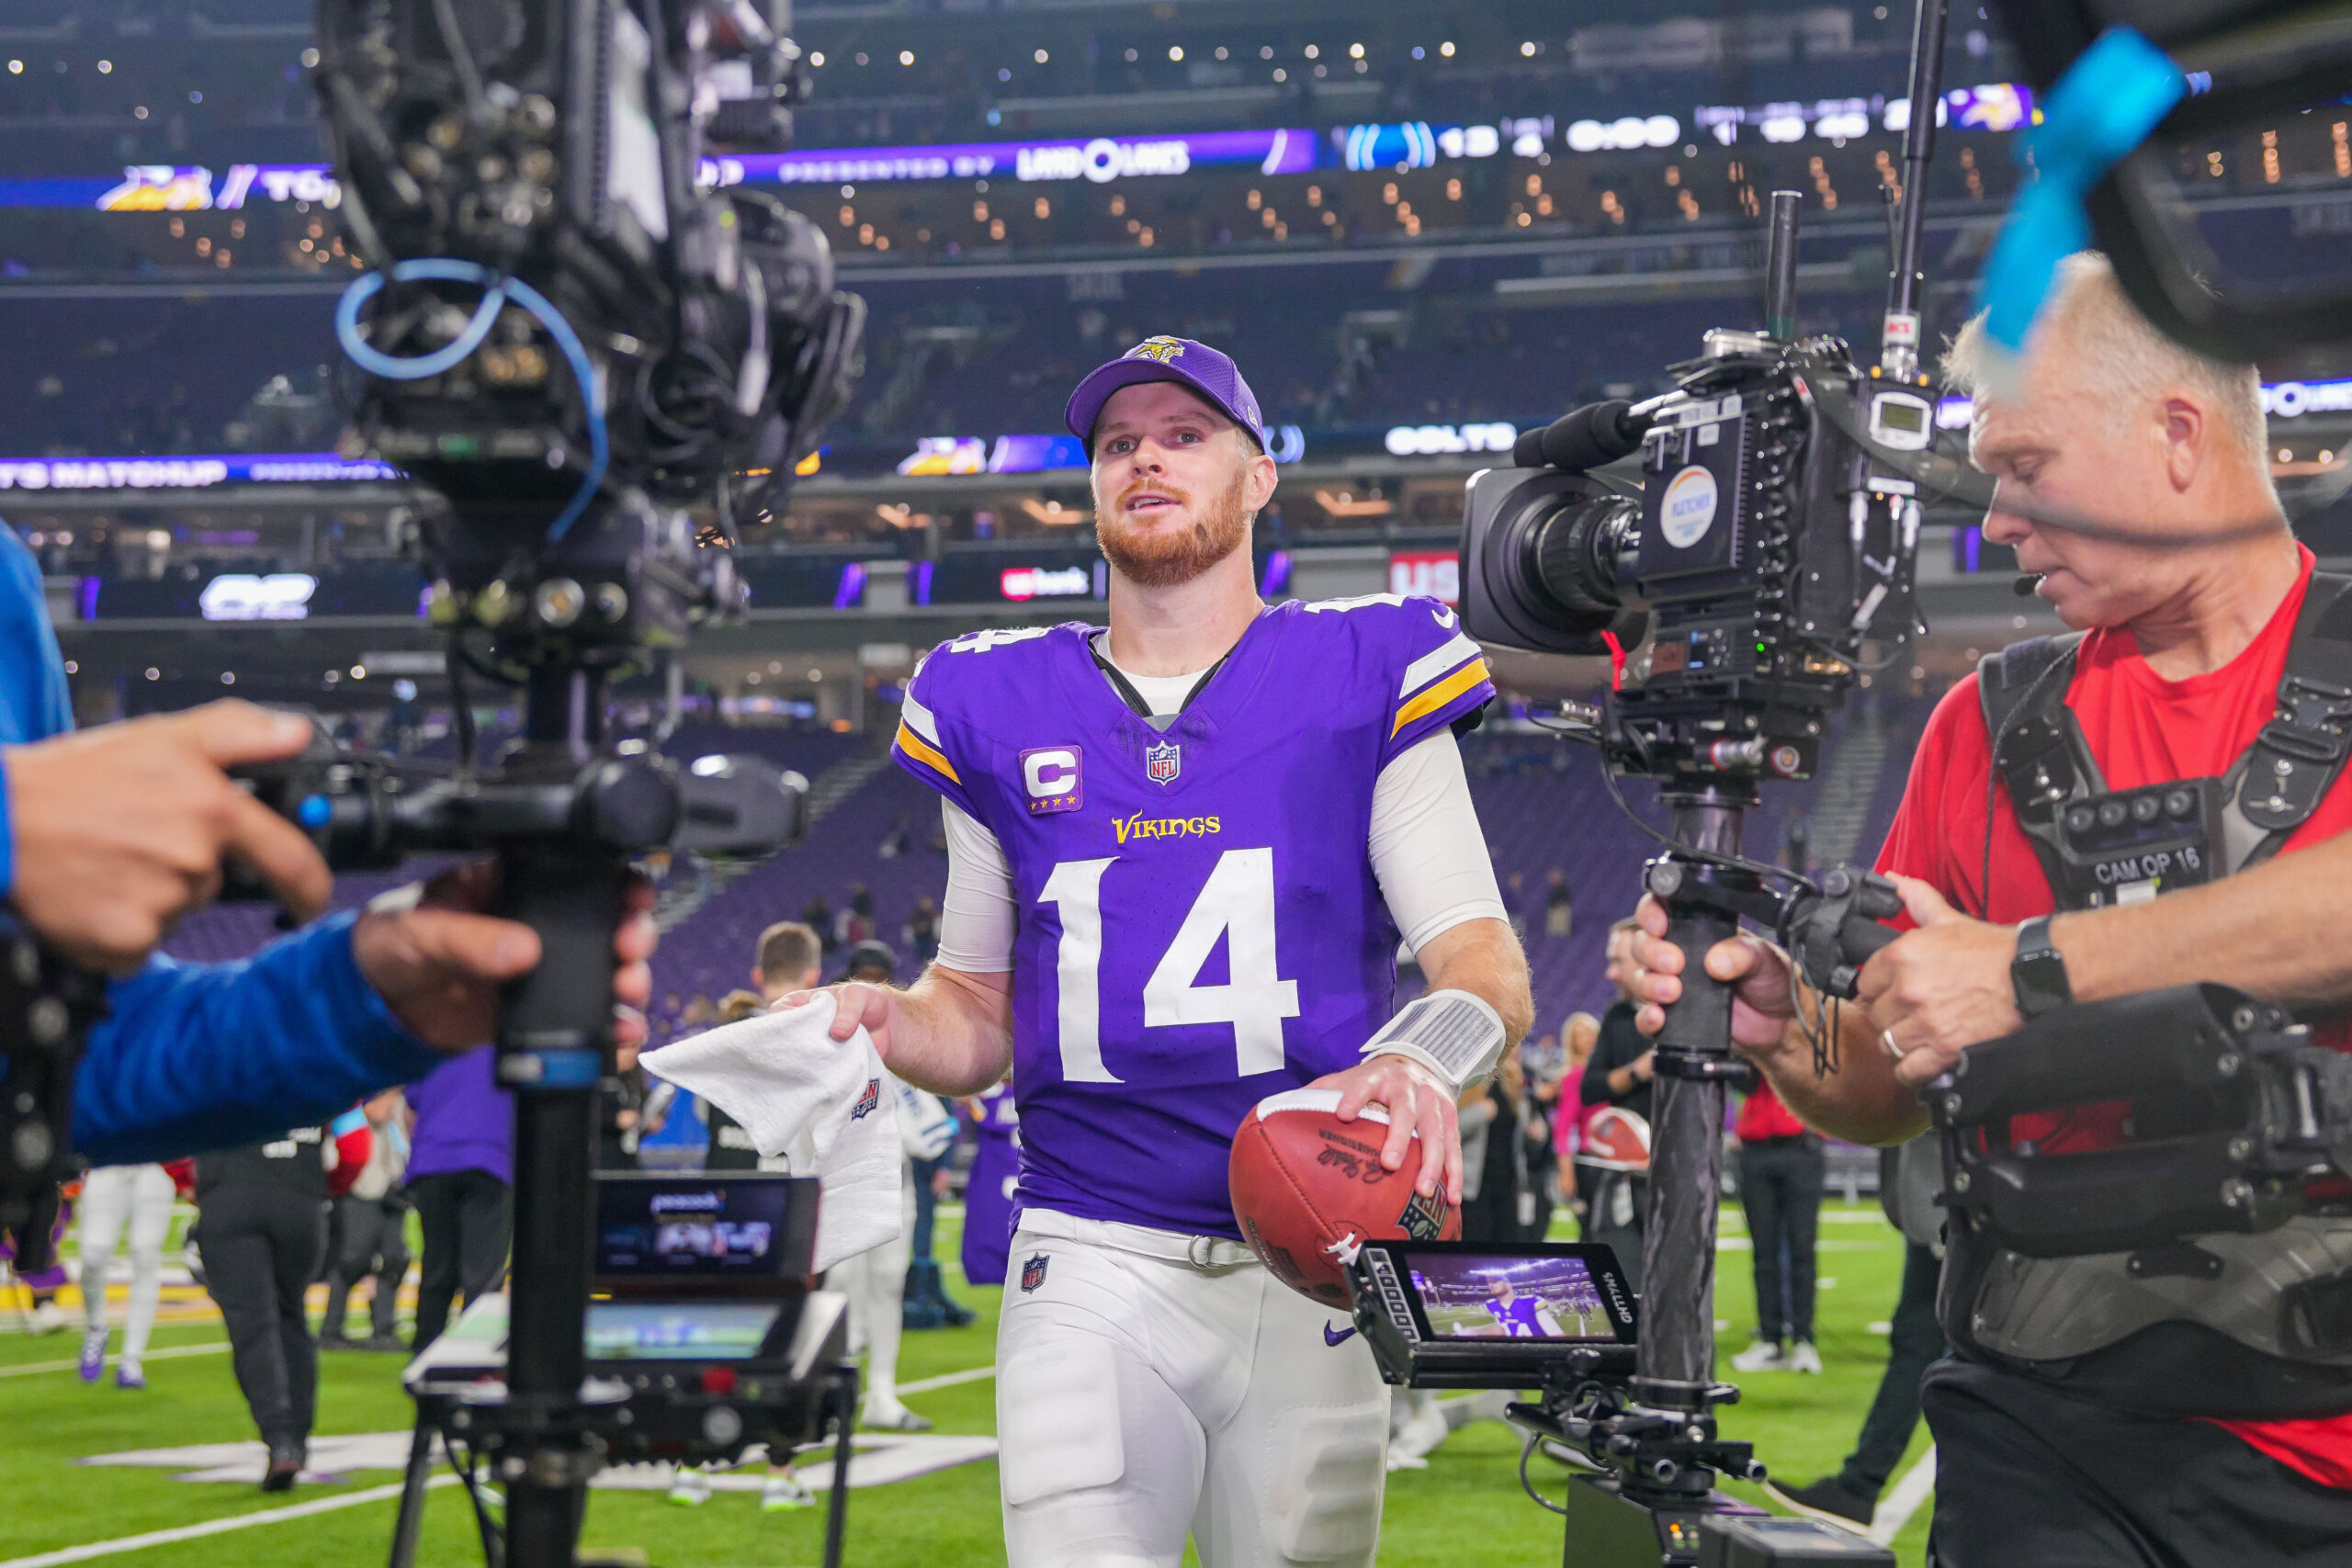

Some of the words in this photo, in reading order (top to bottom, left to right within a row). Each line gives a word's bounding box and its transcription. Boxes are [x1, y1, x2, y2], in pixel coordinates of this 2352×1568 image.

[1016, 146, 1084, 182] LAND
[1082, 138, 1121, 184] O
[1120, 141, 1191, 176] LAKES
[1385, 422, 1518, 456] COLTS
[50, 459, 229, 489] MATCHUP
[1024, 750, 1077, 798] C
[1151, 761, 1175, 777] NFL
[2094, 858, 2142, 886] CAM
[2142, 852, 2171, 877] OP
[2175, 847, 2201, 870] 16
[1037, 846, 1301, 1083] 14
[1023, 1269, 1042, 1287] NFL
[1601, 1271, 1634, 1325] SMALLHD
